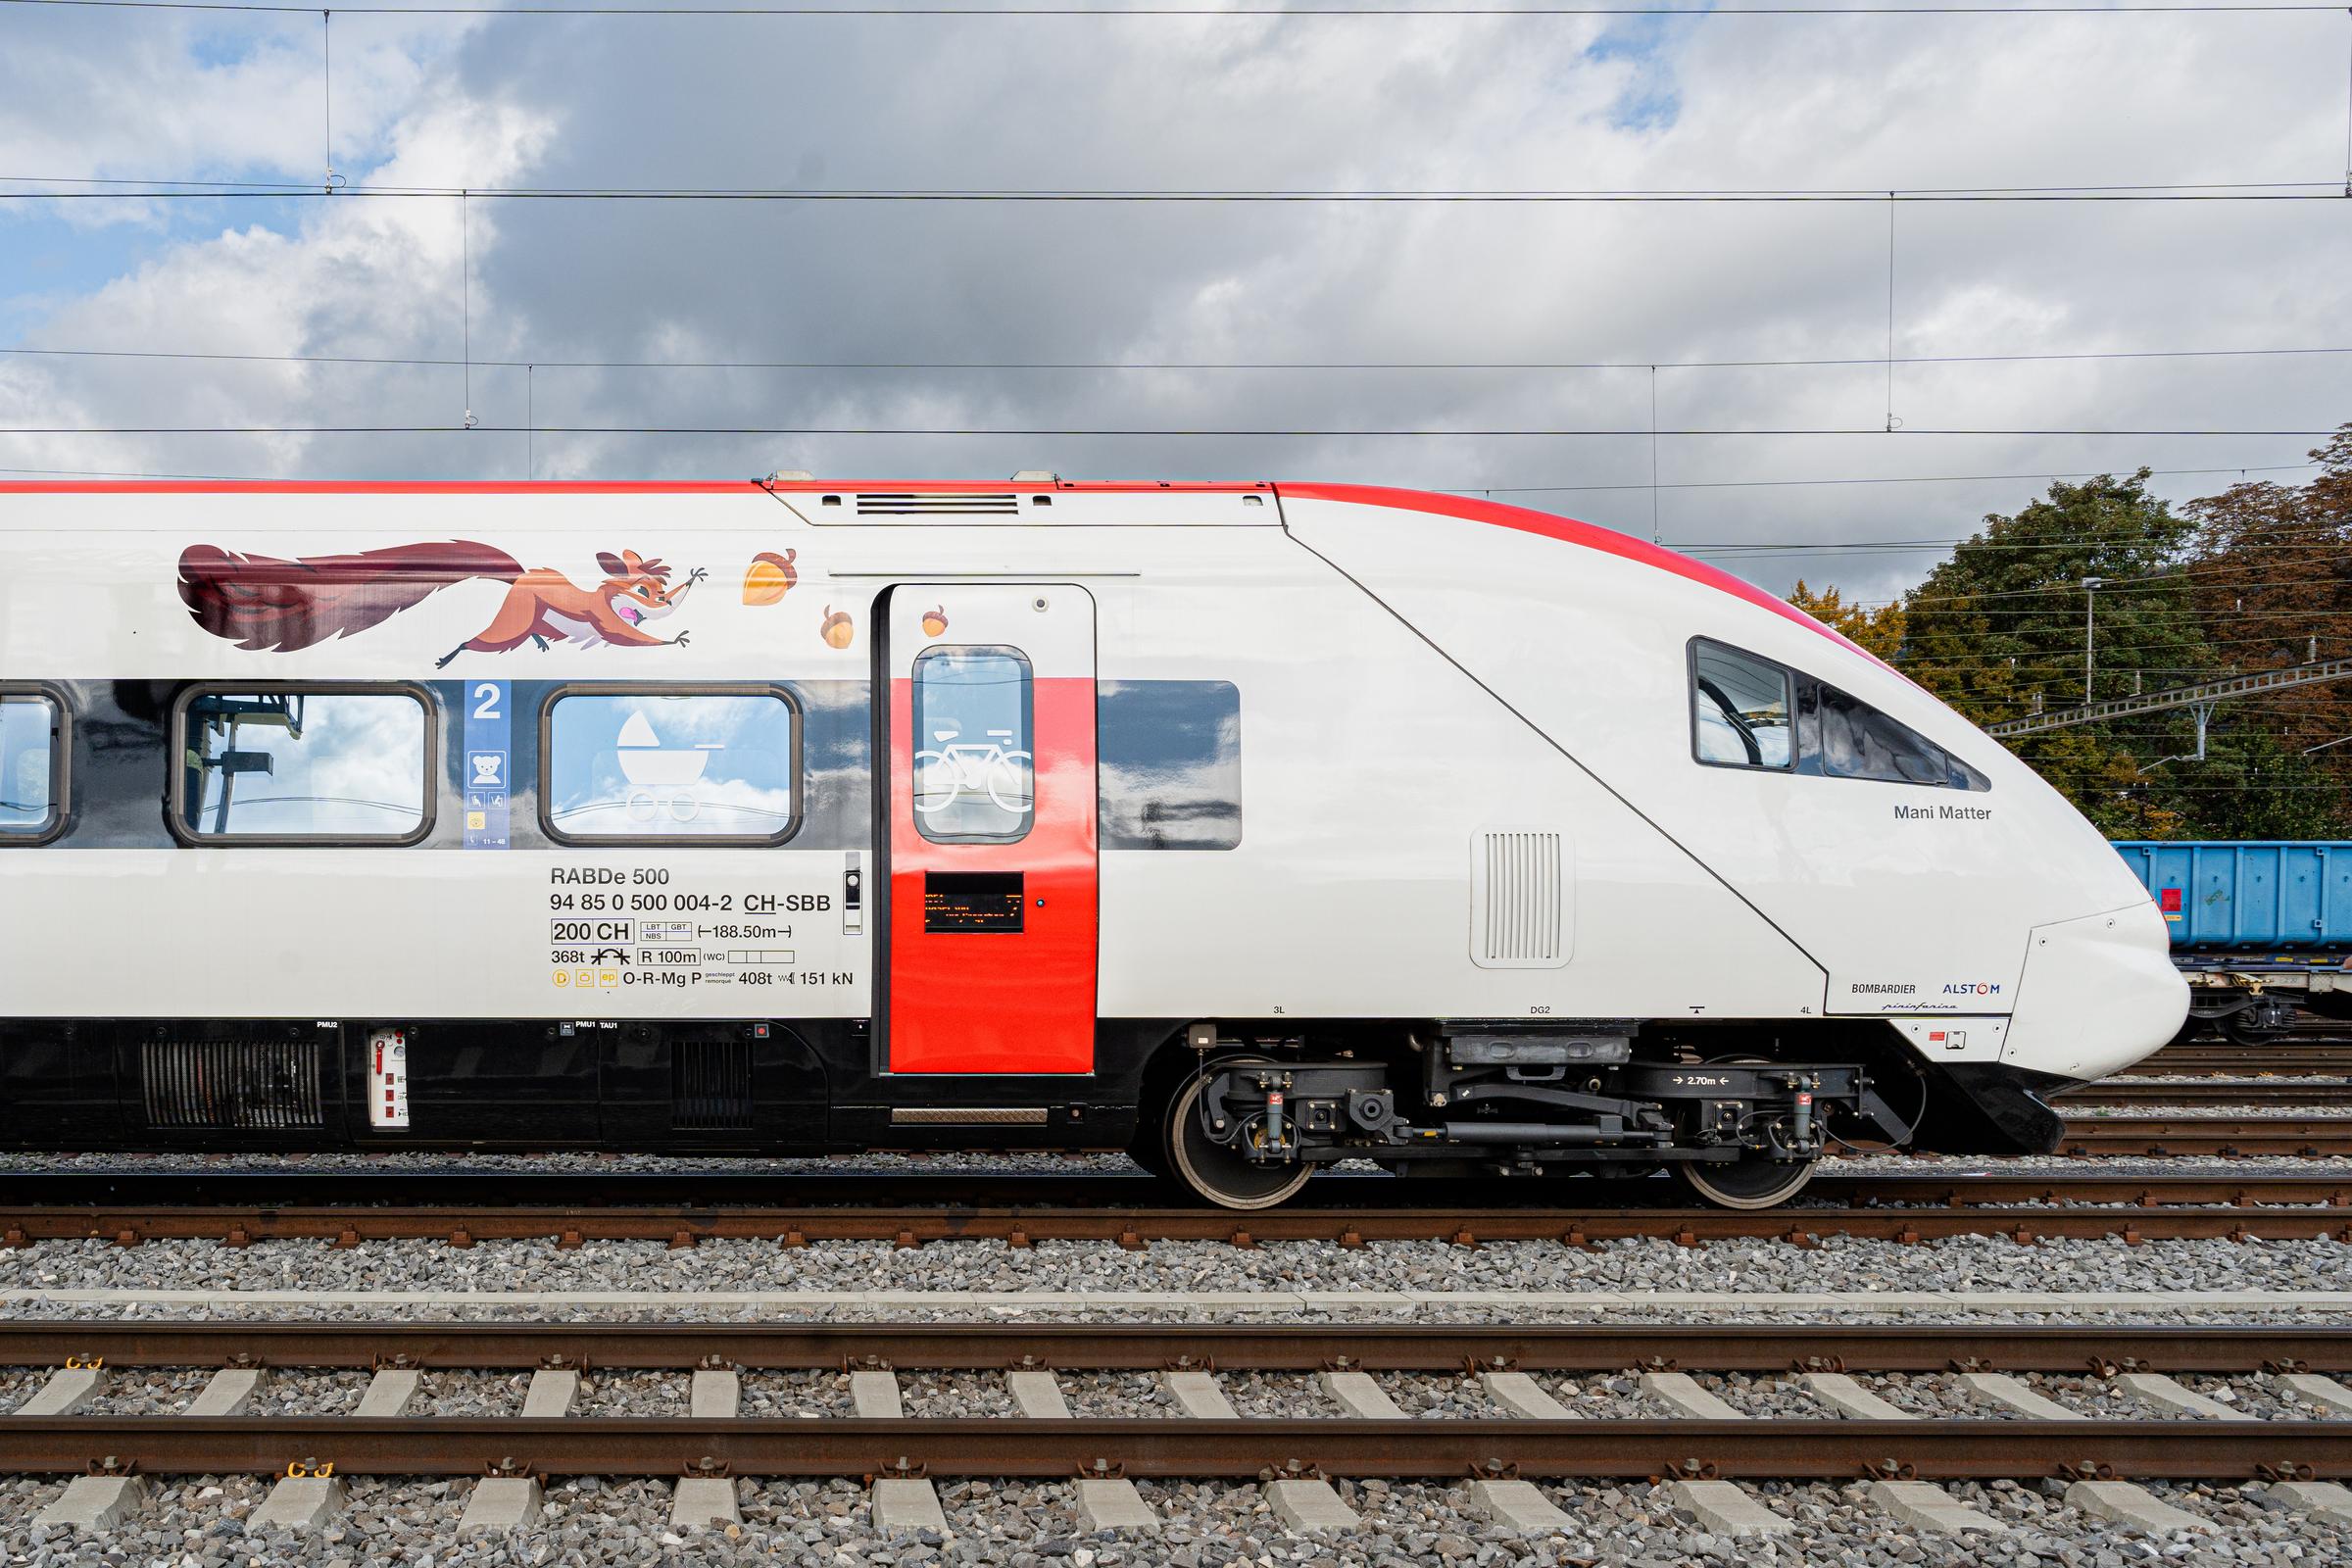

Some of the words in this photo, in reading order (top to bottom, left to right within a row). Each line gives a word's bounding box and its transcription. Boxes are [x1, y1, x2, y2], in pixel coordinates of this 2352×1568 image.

[472, 683, 501, 719] 2
[1894, 805, 1935, 819] Mani
[1938, 806, 1992, 820] Matter
[551, 867, 626, 885] RABDe
[632, 868, 669, 885] 500
[550, 893, 575, 910] 94
[580, 894, 606, 910] 85
[612, 894, 624, 910] 0
[630, 894, 667, 911] 500
[673, 894, 732, 911] 004-2
[744, 894, 831, 915] CH-SBB
[553, 923, 591, 941] 200
[596, 922, 629, 941] CH
[551, 950, 585, 963] 368t
[642, 951, 653, 963] R
[658, 951, 697, 963] 100m
[703, 953, 725, 961] (WC)
[556, 972, 567, 984] D
[602, 973, 615, 983] ep
[622, 971, 686, 988] O-R-Mg
[691, 971, 702, 985] P
[738, 971, 772, 985] 408t
[800, 972, 825, 985] 151
[832, 972, 854, 985] kN
[1851, 983, 1916, 994] BOMBARDIER
[1942, 982, 2001, 995] ALSTOM
[1273, 1005, 1285, 1014] 3L
[1530, 1005, 1550, 1014] DG2
[1800, 1005, 1812, 1014] 4L
[1882, 1003, 1959, 1011] pininfarina
[1687, 1076, 1716, 1086] 2.70m
